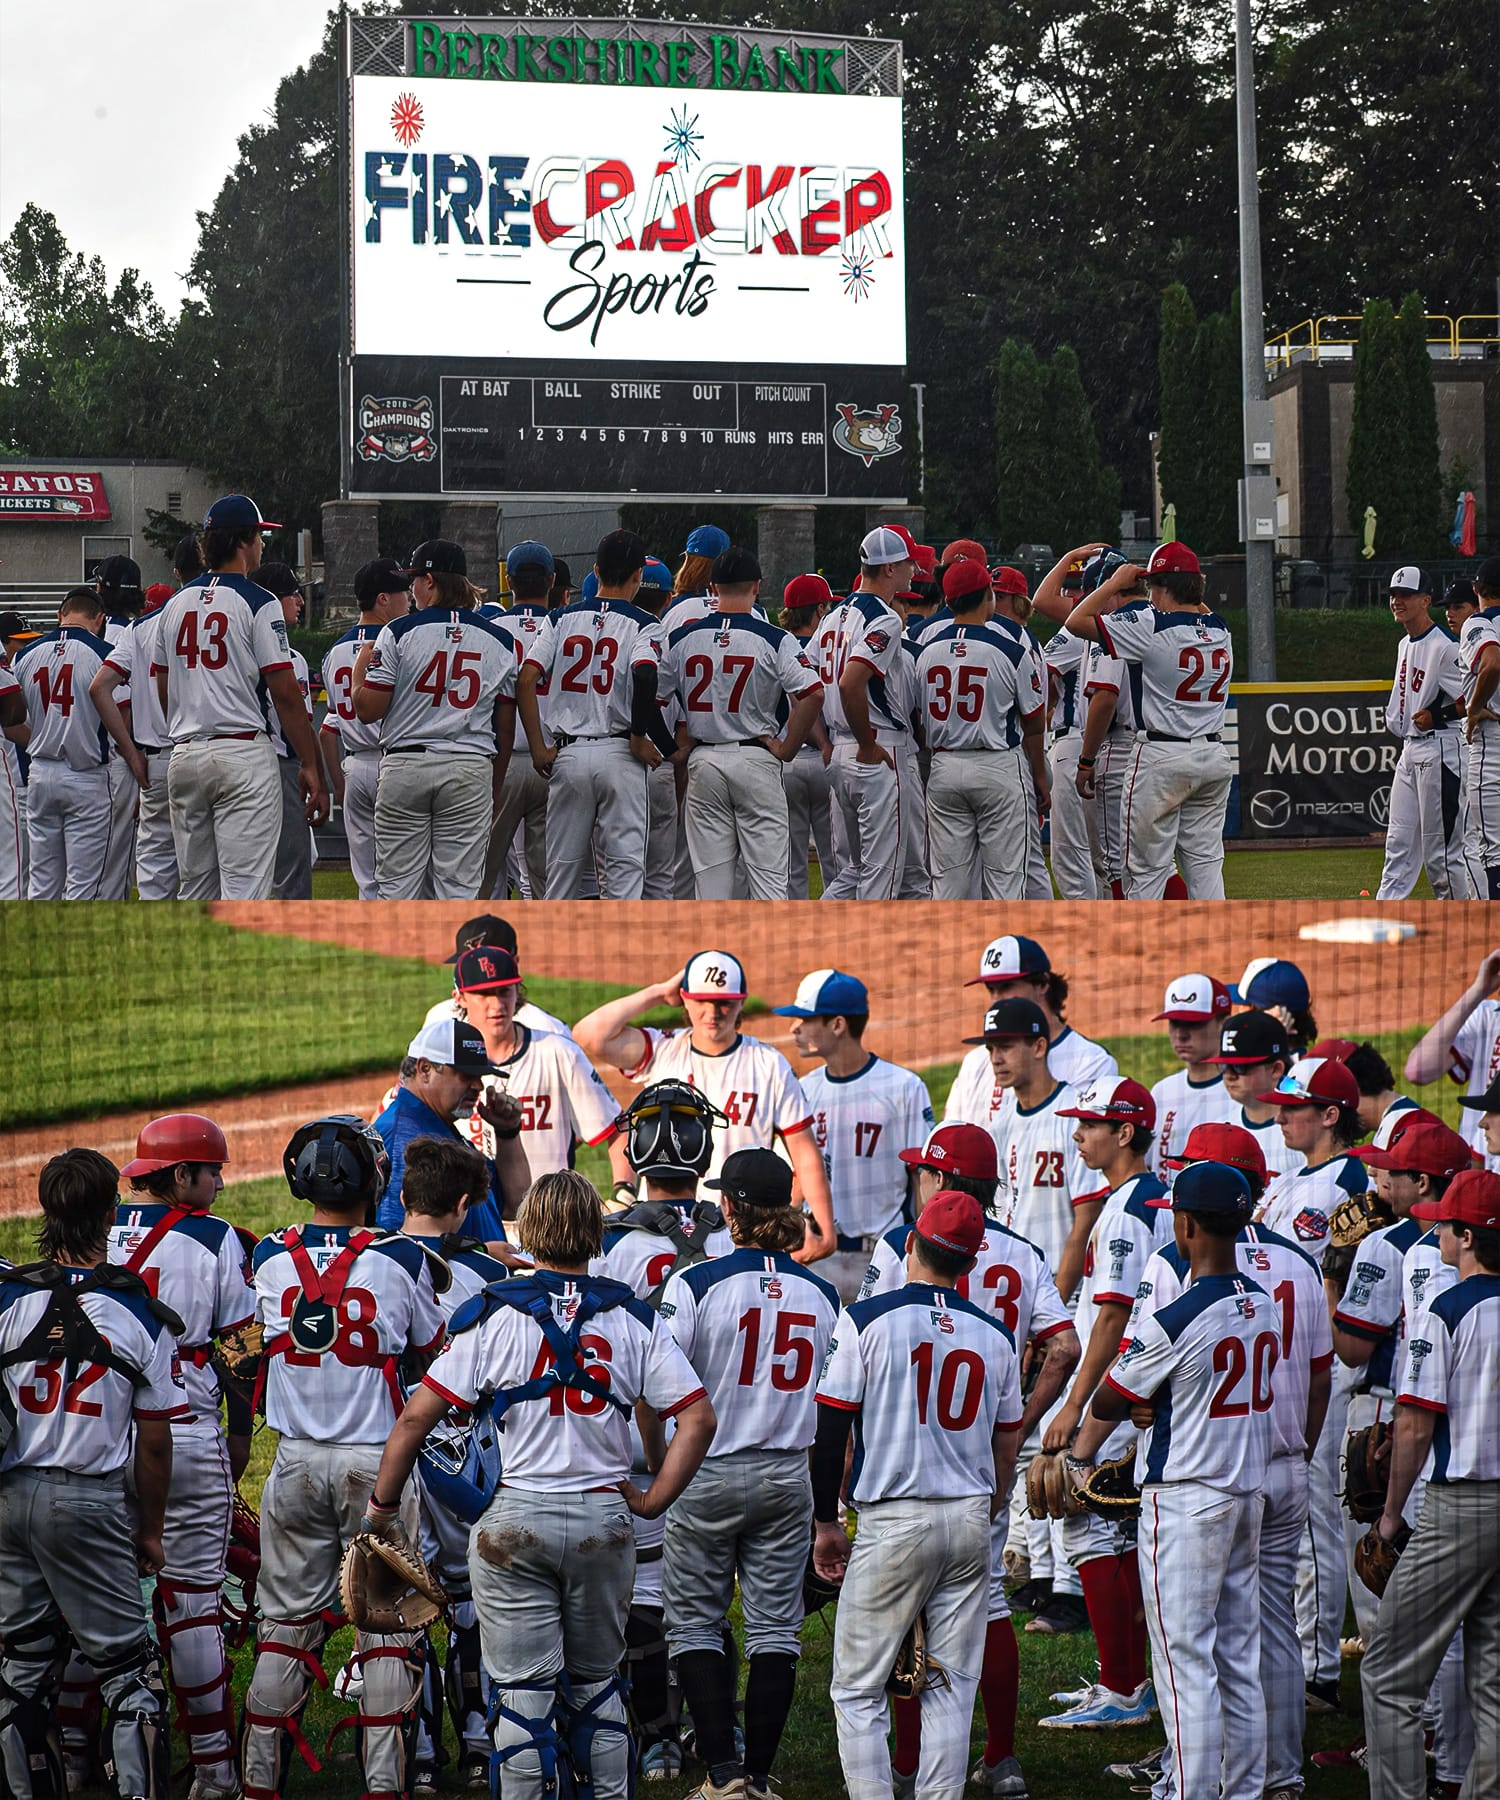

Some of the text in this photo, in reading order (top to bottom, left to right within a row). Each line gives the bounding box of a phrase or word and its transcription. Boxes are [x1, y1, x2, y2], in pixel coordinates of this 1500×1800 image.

[412, 22, 845, 94] BERKSHIRE BANK
[365, 151, 893, 258] FIRECRACKER
[543, 240, 717, 347] Sports
[460, 381, 510, 396] AT BAT
[545, 382, 722, 400] BALL STRIKE OUT
[755, 386, 812, 402] PITCH COUNT
[363, 410, 431, 429] CHAMPIONS
[518, 429, 824, 445] 1 2 3 4 5 6 7 8 9 10 RUNS HITS ERR
[176, 611, 229, 670] 43
[561, 635, 619, 695] 23
[33, 664, 75, 717] 14
[415, 651, 481, 709] 45
[685, 654, 755, 713] 27
[927, 665, 989, 722] 35
[1175, 646, 1230, 703] 22
[1265, 703, 1388, 735] COOLE
[984, 1009, 1000, 1032] E
[1222, 1030, 1239, 1052] E
[518, 1095, 552, 1131] 52
[723, 1090, 759, 1126] 47
[855, 1121, 882, 1158] 17
[1033, 1151, 1065, 1188] 23
[18, 1334, 112, 1417] 32
[738, 1307, 817, 1393] 15
[1209, 1331, 1280, 1419] 20
[911, 1342, 986, 1431] 10
